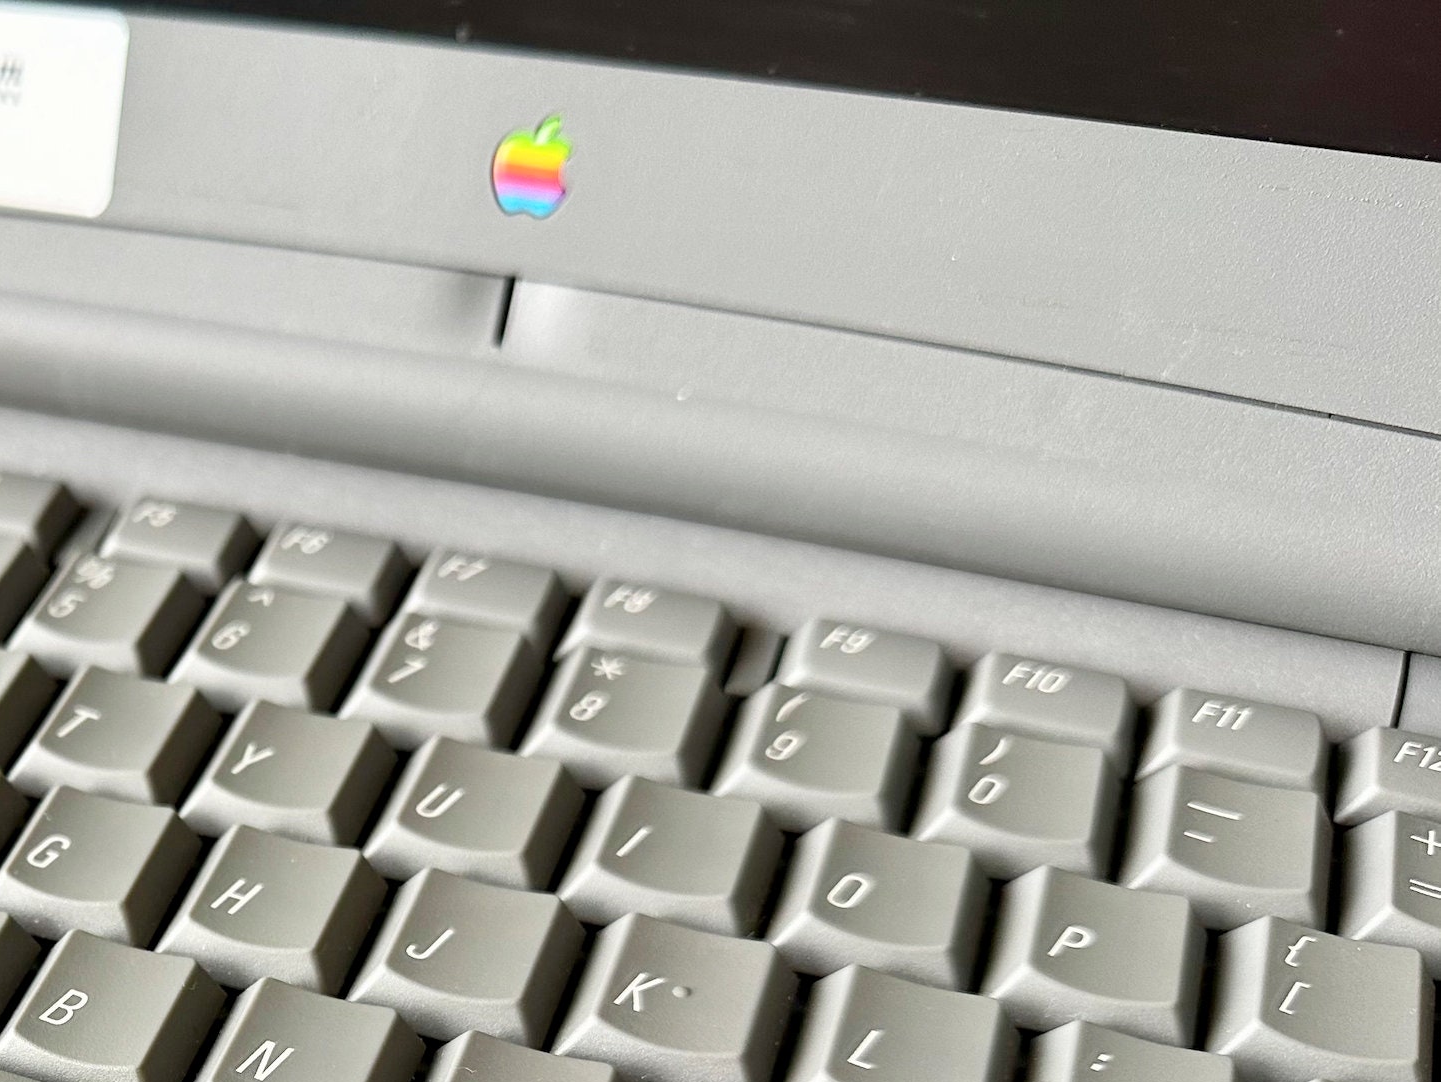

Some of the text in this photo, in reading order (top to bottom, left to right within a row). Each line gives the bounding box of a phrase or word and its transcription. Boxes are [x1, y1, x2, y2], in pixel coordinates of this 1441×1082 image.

[281, 527, 332, 554] F6
[438, 555, 489, 581] F7
[47, 588, 85, 618] 5
[604, 585, 657, 614] F8
[211, 620, 252, 650] 6
[405, 619, 440, 651] &
[820, 624, 876, 654] F9
[386, 654, 428, 684] 7
[1002, 661, 1072, 694] F10
[57, 705, 103, 739] T
[569, 690, 609, 722] 8
[1193, 701, 1252, 730] F11
[230, 742, 275, 775] Y
[765, 729, 806, 761] 9
[415, 782, 465, 818] U
[968, 774, 1009, 805] 0
[26, 833, 72, 869] G
[210, 878, 265, 915] H
[827, 872, 876, 908] O
[405, 927, 456, 961] J
[1047, 925, 1097, 957] P
[1284, 935, 1317, 967] {
[38, 988, 90, 1026] B
[613, 972, 667, 1012] K
[1279, 980, 1311, 1015] [
[235, 1039, 295, 1081] N
[847, 1028, 884, 1070] L
[1089, 1052, 1113, 1072] :
